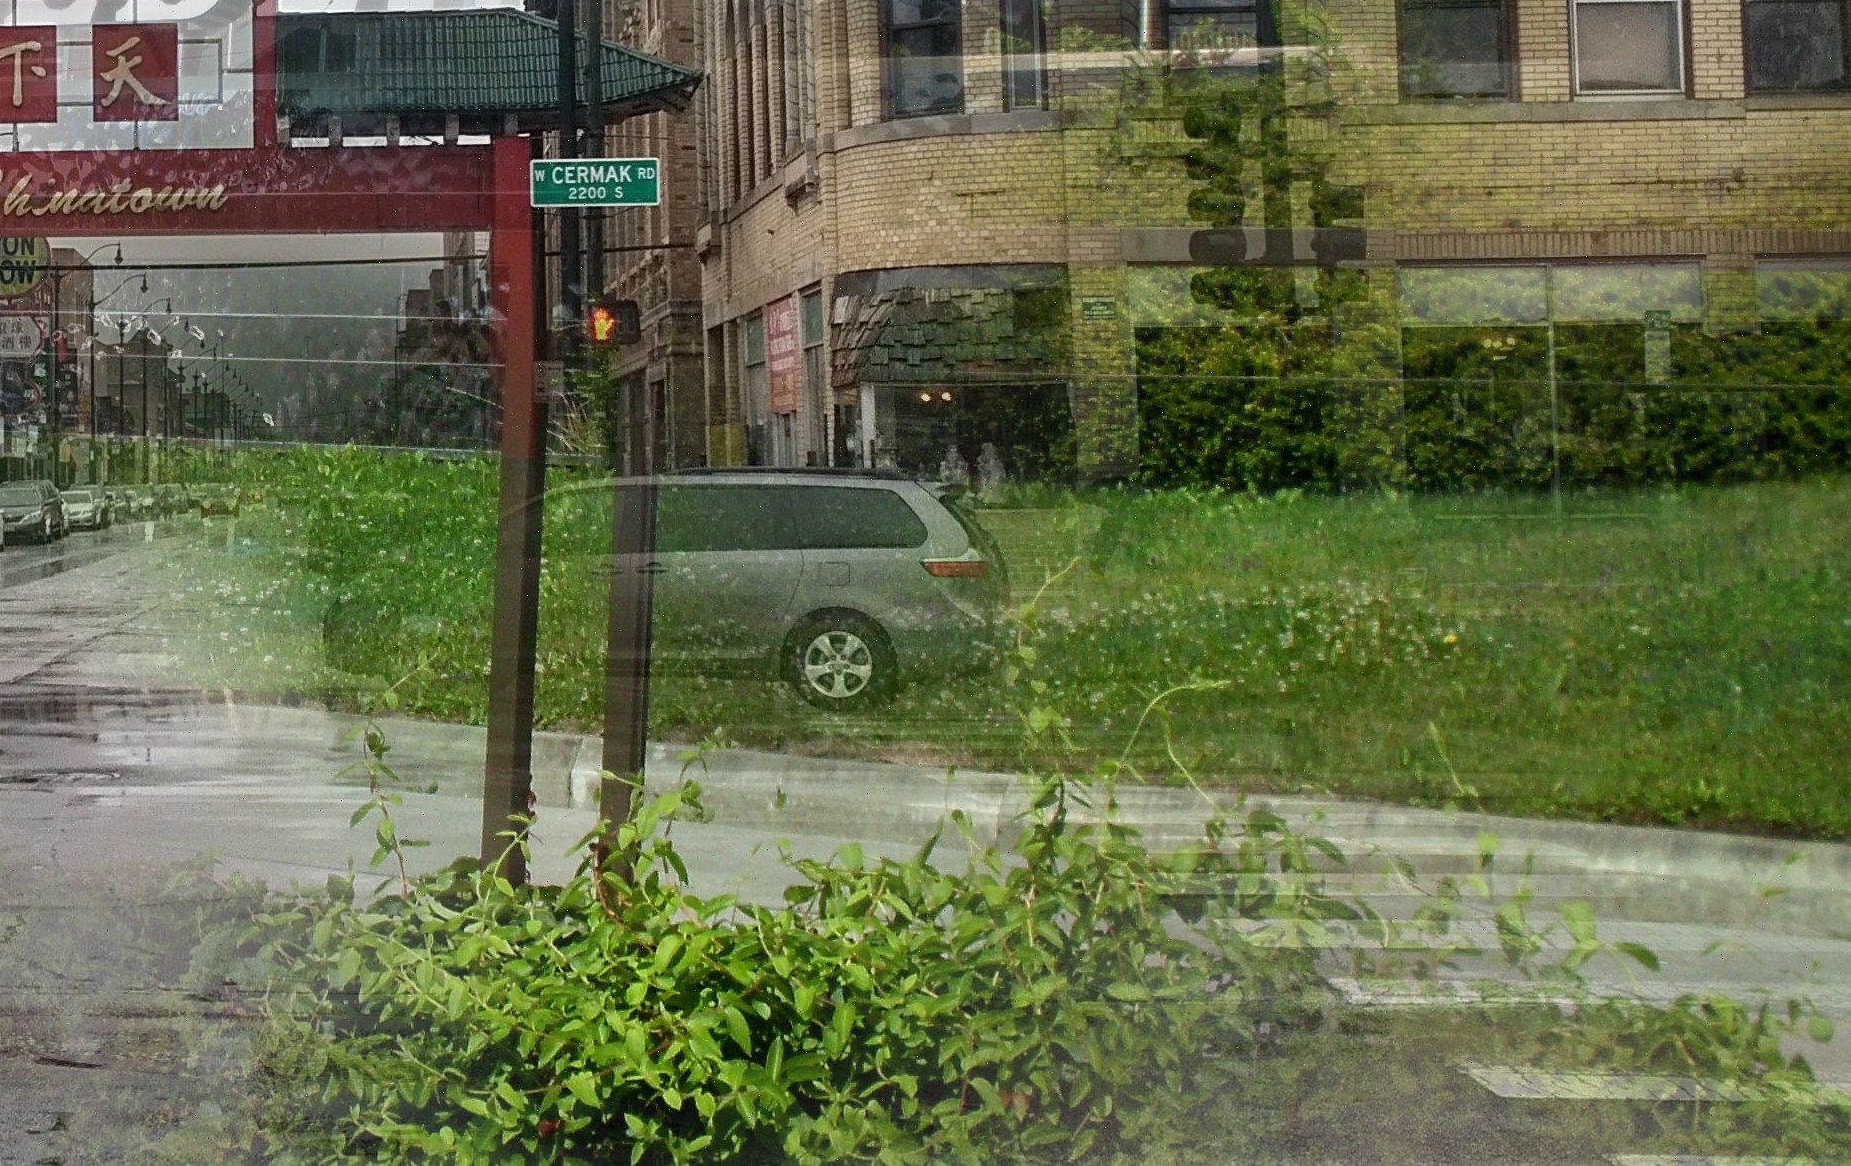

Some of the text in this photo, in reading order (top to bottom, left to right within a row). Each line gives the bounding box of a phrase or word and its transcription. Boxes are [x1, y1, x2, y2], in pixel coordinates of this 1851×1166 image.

[534, 165, 655, 184] W CERMAK RD
[568, 186, 624, 200] 2200 S
